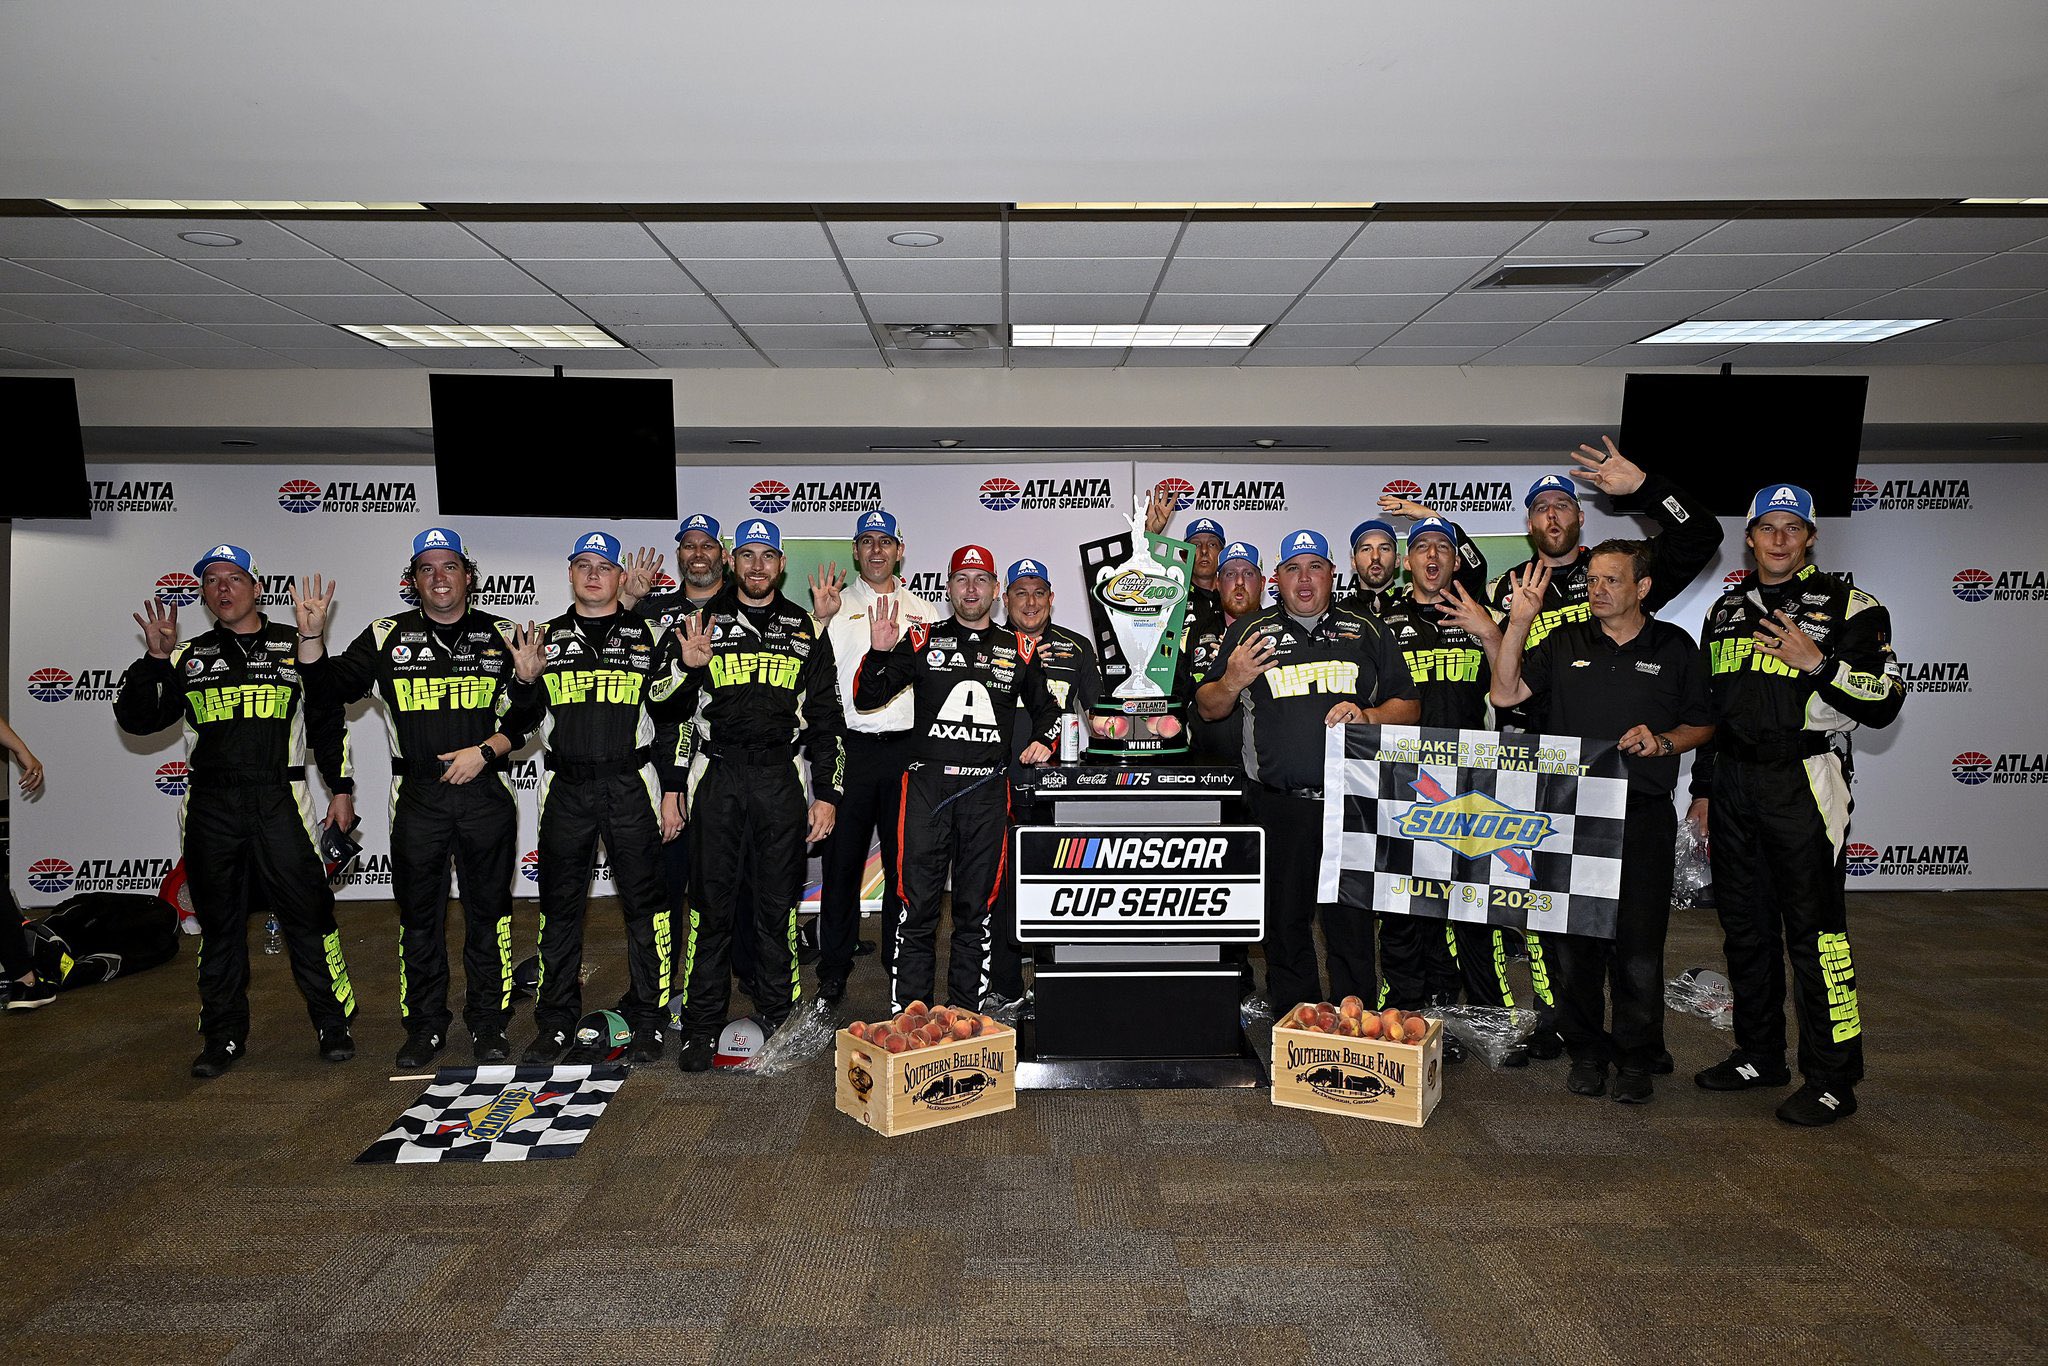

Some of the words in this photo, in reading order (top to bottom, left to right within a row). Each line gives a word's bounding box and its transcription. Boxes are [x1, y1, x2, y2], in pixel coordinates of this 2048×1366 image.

[323, 482, 417, 500] ATLANTA
[792, 482, 881, 500] ATLANTA
[1022, 479, 1111, 498] ATLANTA
[1196, 481, 1285, 500] ATLANTA
[1424, 483, 1512, 500] ATLANTA
[1880, 480, 1970, 498] ATLANTA
[117, 500, 174, 512] SPEEDWAY
[322, 501, 359, 513] MOTOR
[361, 501, 417, 513] SPEEDWAY
[792, 501, 827, 513] MOTOR
[829, 501, 881, 512] SPEEDWAY
[1021, 498, 1056, 510] MOTOR
[1058, 498, 1111, 509] SPEEDWAY
[1195, 500, 1230, 511] MOTOR
[1232, 500, 1285, 511] SPEEDWAY
[1459, 501, 1512, 512] SPEEDWAY
[1879, 499, 1914, 510] MOTOR
[1917, 499, 1970, 510] SPEEDWAY
[583, 544, 608, 552] AXALTA
[1119, 577, 1153, 586] QUAKER
[1143, 586, 1178, 599] 400
[1994, 590, 2028, 601] MOTOR
[481, 594, 536, 606] SPEEDWAY
[1798, 621, 1830, 633] Hendrick
[708, 652, 801, 690] RAPTOR
[993, 682, 1012, 690] RELAY
[1264, 660, 1358, 699] RAPTOR
[393, 676, 497, 712] RAPTOR
[542, 669, 643, 706] RAPTOR
[1917, 682, 1969, 693] SPEEDWAY
[75, 689, 113, 701] MOTOR
[185, 684, 292, 724] RAPTOR
[928, 723, 1001, 743] AXALTA
[1128, 741, 1161, 750] WINNER
[1397, 738, 1470, 756] QUAKER
[1475, 743, 1529, 760] STATE
[1534, 747, 1567, 762] 400
[1374, 749, 1468, 768] AVAILABLE
[1472, 757, 1495, 769] AT
[1500, 759, 1590, 777] WALMART
[959, 767, 994, 776] BYRON
[1042, 775, 1067, 785] BUSCH
[1133, 773, 1151, 786] 75
[1158, 775, 1196, 783] GEICO
[1200, 774, 1235, 786] xfinity
[1993, 773, 2028, 784] MOTOR
[1407, 809, 1543, 843] SUNOCO
[1095, 838, 1229, 869] NASCAR
[1880, 846, 1969, 863] ATLANTA
[76, 859, 173, 878] ATLANTA
[1880, 864, 1915, 875] MOTOR
[1917, 864, 1969, 875] SPEEDWAY
[75, 878, 113, 891] MOTOR
[1391, 877, 1454, 900] JULY
[1461, 886, 1484, 908] 9,
[1491, 889, 1553, 912] 2023
[1050, 888, 1116, 917] CUP
[1118, 887, 1231, 917] SERIES
[1818, 932, 1861, 1043] RAPTOR
[1287, 1040, 1340, 1070] SOUTHERN
[1343, 1047, 1375, 1069] BELLE
[1377, 1052, 1406, 1087] FARM
[904, 1057, 951, 1094] SOUTHERN
[953, 1052, 980, 1069] BELLE
[982, 1047, 1004, 1073] FARM
[477, 1090, 524, 1137] SUNOCO
